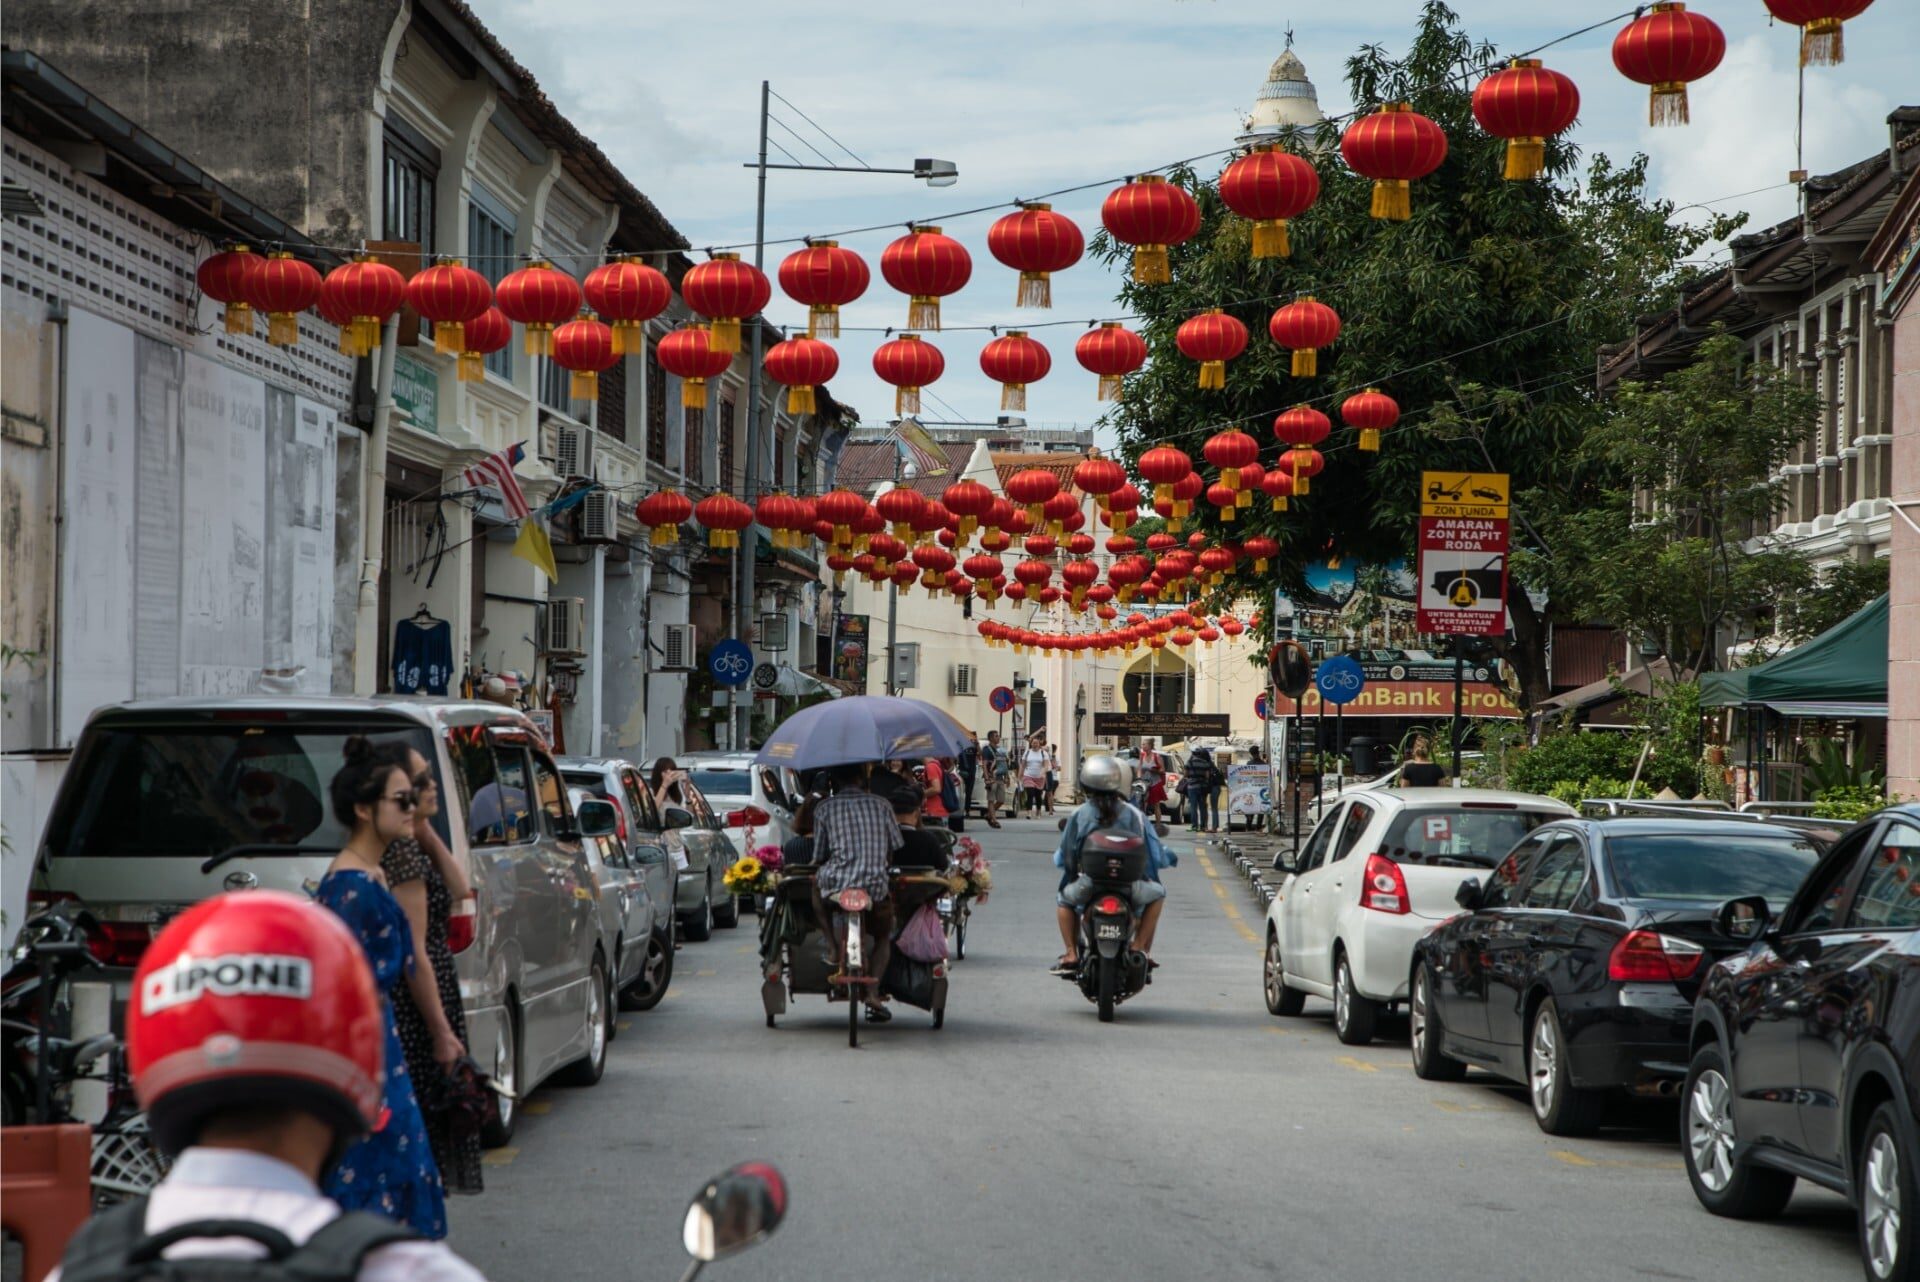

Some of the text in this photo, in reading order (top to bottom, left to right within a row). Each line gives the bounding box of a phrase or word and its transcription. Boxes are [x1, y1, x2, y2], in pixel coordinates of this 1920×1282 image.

[1434, 505, 1496, 516] ZON TUNDA
[1436, 519, 1494, 530] AMARAN
[1426, 529, 1502, 541] ZON KAPIT
[1445, 540, 1482, 551] RODA
[1439, 618, 1492, 626] PERTANYAAN
[1330, 687, 1515, 708] mBank Grou
[1427, 819, 1447, 838] P
[175, 963, 300, 993] IPONE
